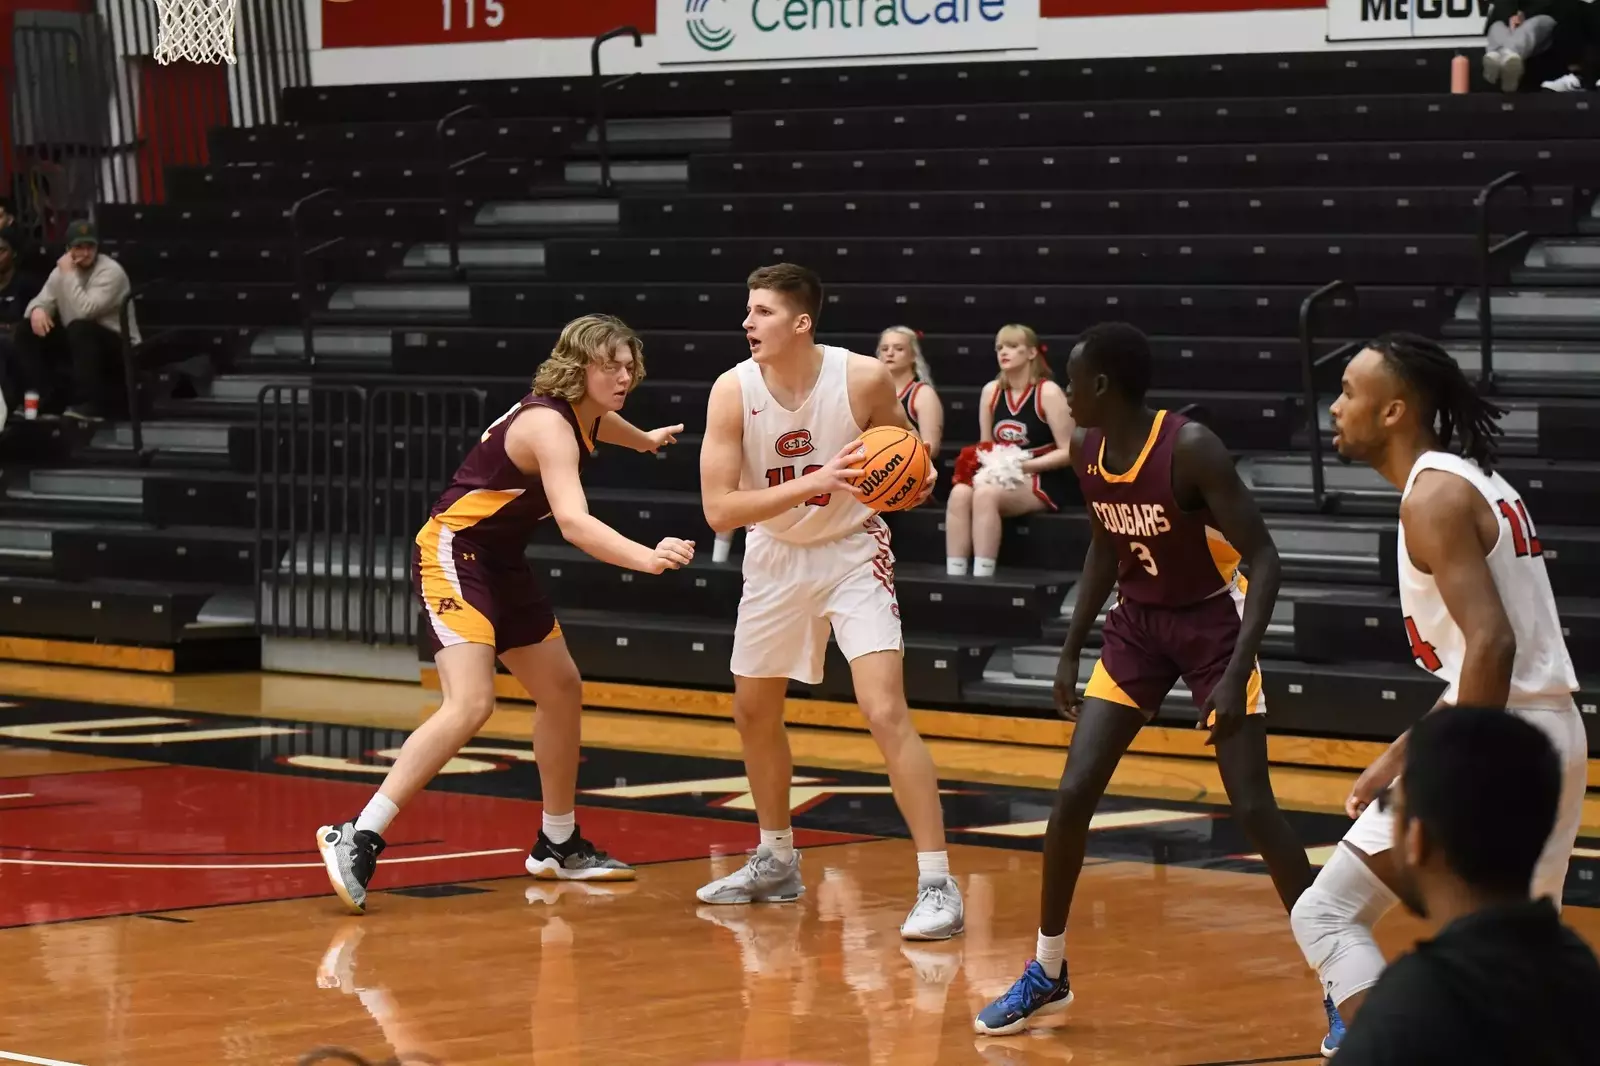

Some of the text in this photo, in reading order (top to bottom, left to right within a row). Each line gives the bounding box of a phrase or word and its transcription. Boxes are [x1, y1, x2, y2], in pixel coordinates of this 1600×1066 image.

[442, 0, 505, 30] 115
[858, 453, 905, 497] Wilson
[885, 476, 917, 507] NCAA
[1092, 501, 1171, 537] COUGARS
[1129, 541, 1159, 577] 3
